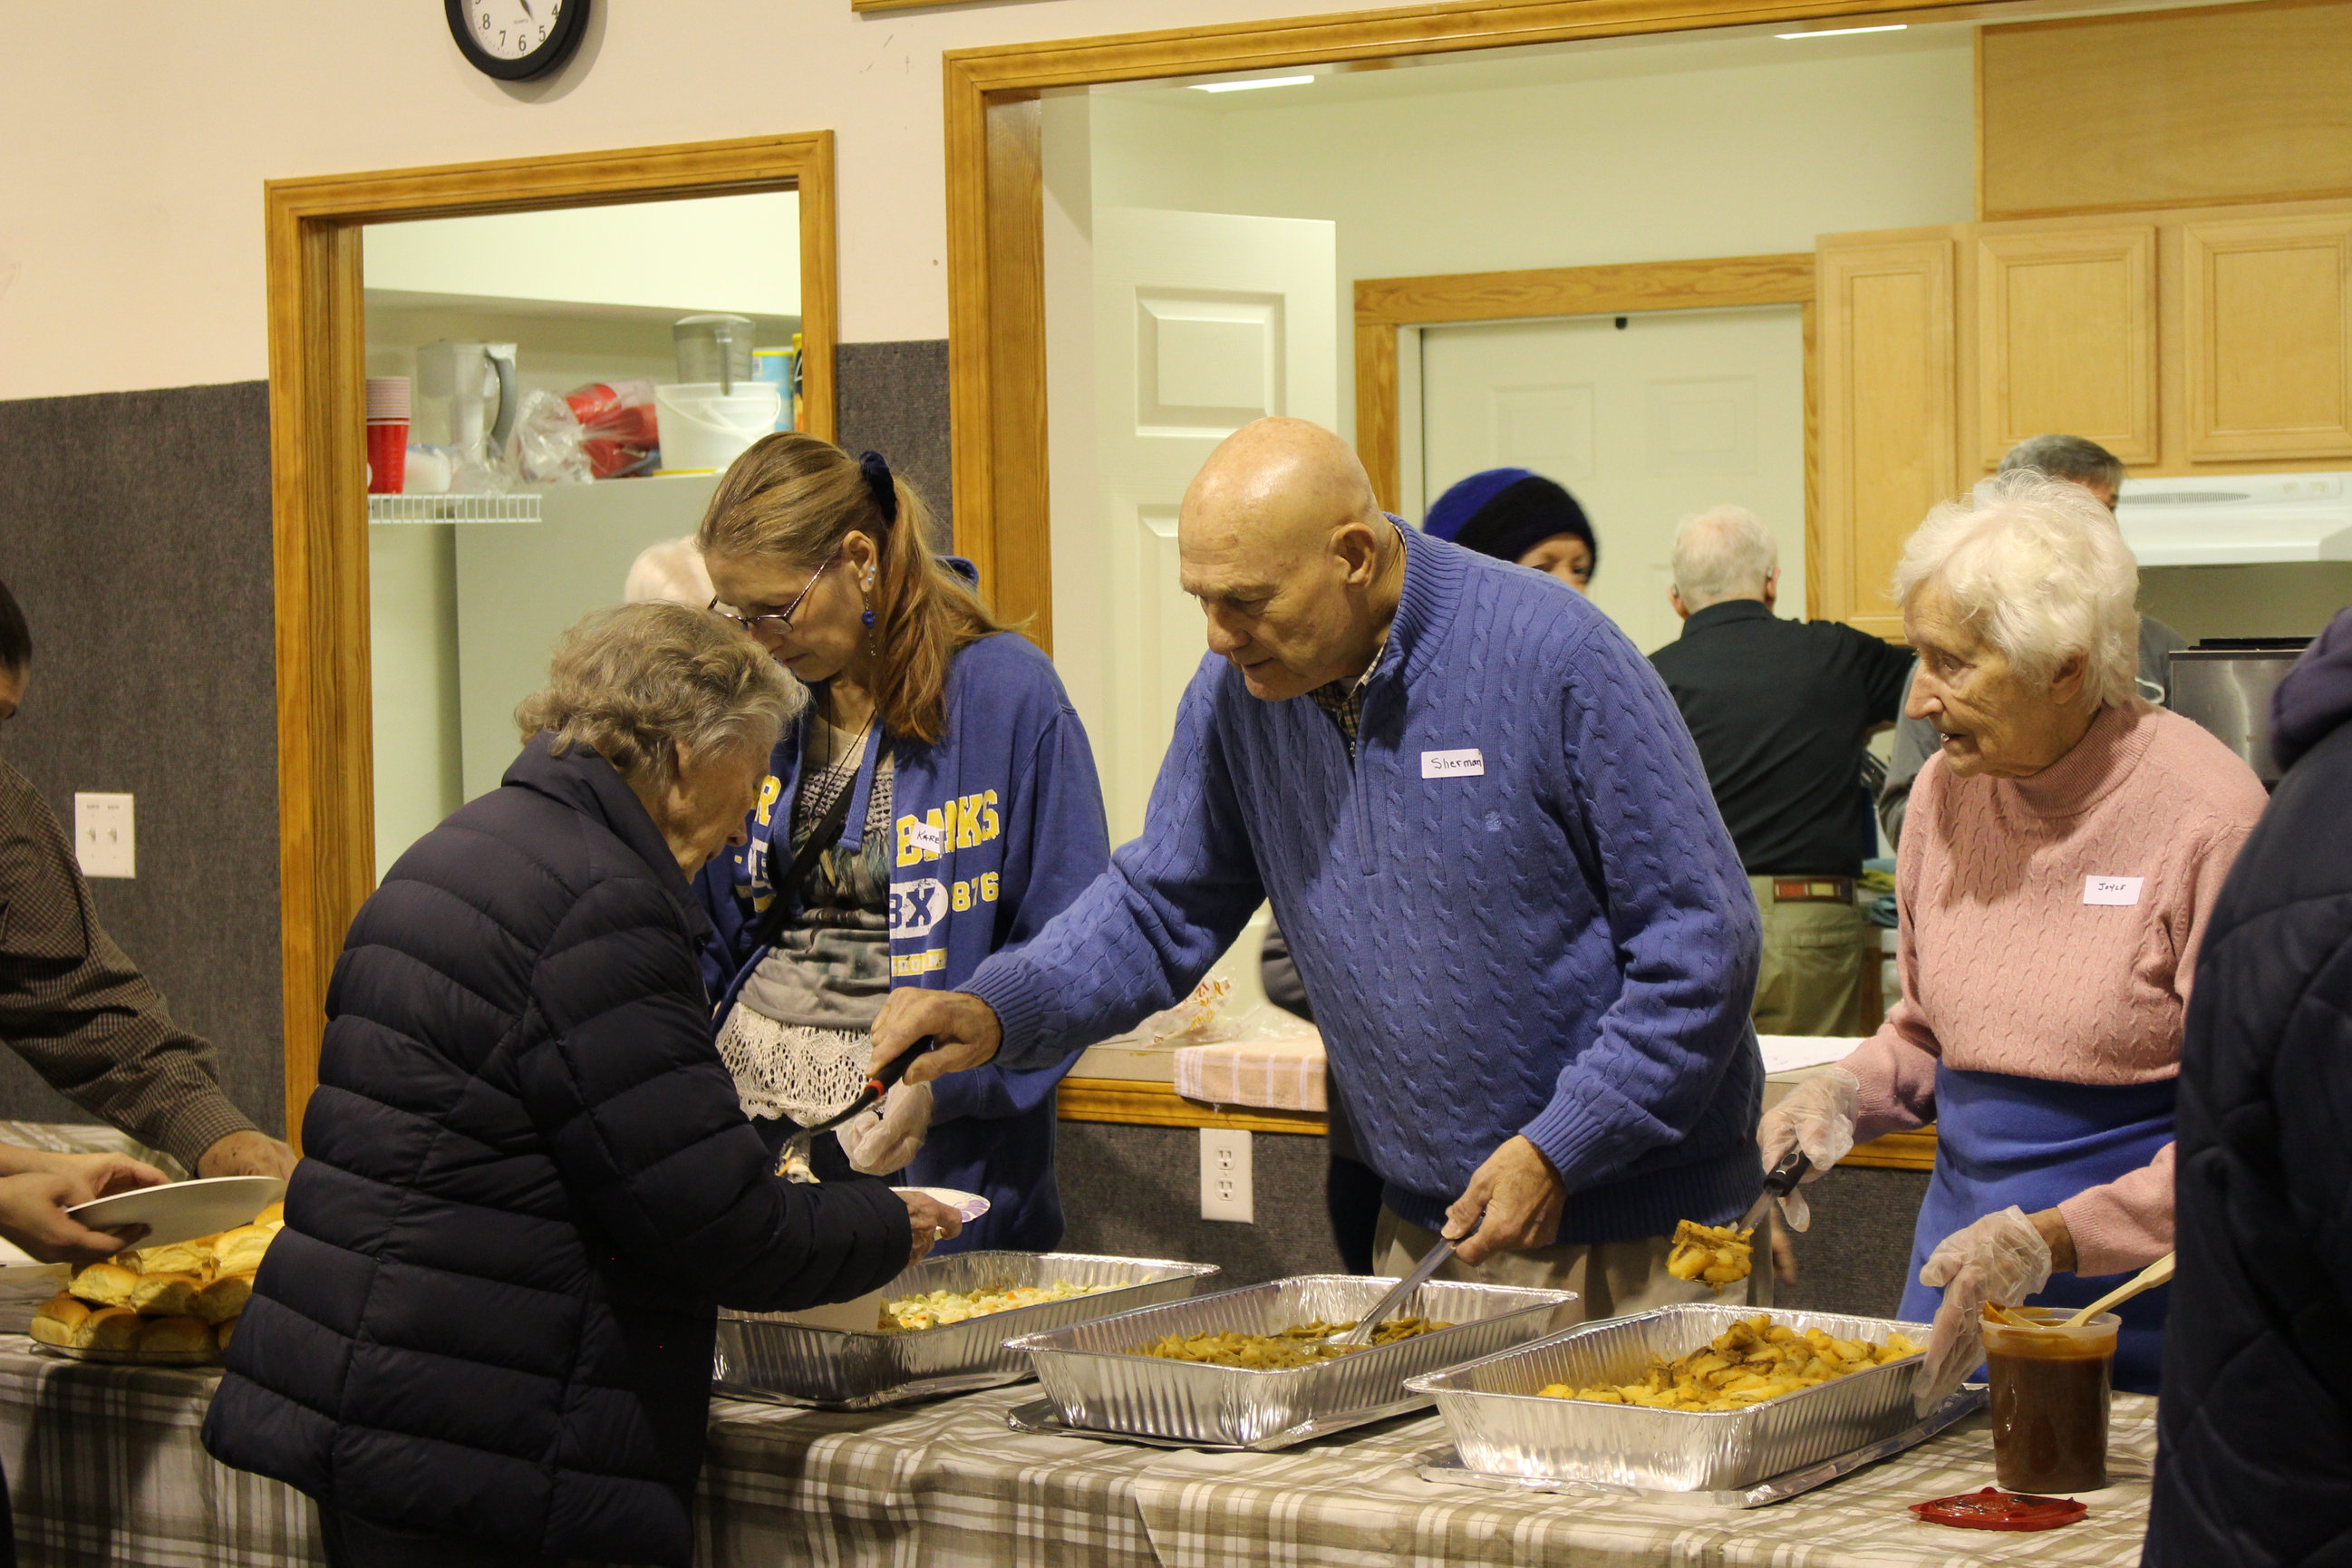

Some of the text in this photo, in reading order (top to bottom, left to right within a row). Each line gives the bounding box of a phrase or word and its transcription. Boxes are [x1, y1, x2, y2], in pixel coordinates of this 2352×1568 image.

[551, 4, 559, 19] 4
[482, 13, 490, 30] 8
[499, 30, 507, 47] 7
[538, 24, 546, 42] 5
[518, 34, 527, 52] 6
[1430, 757, 1482, 769] Sherman
[952, 871, 1000, 913] 876
